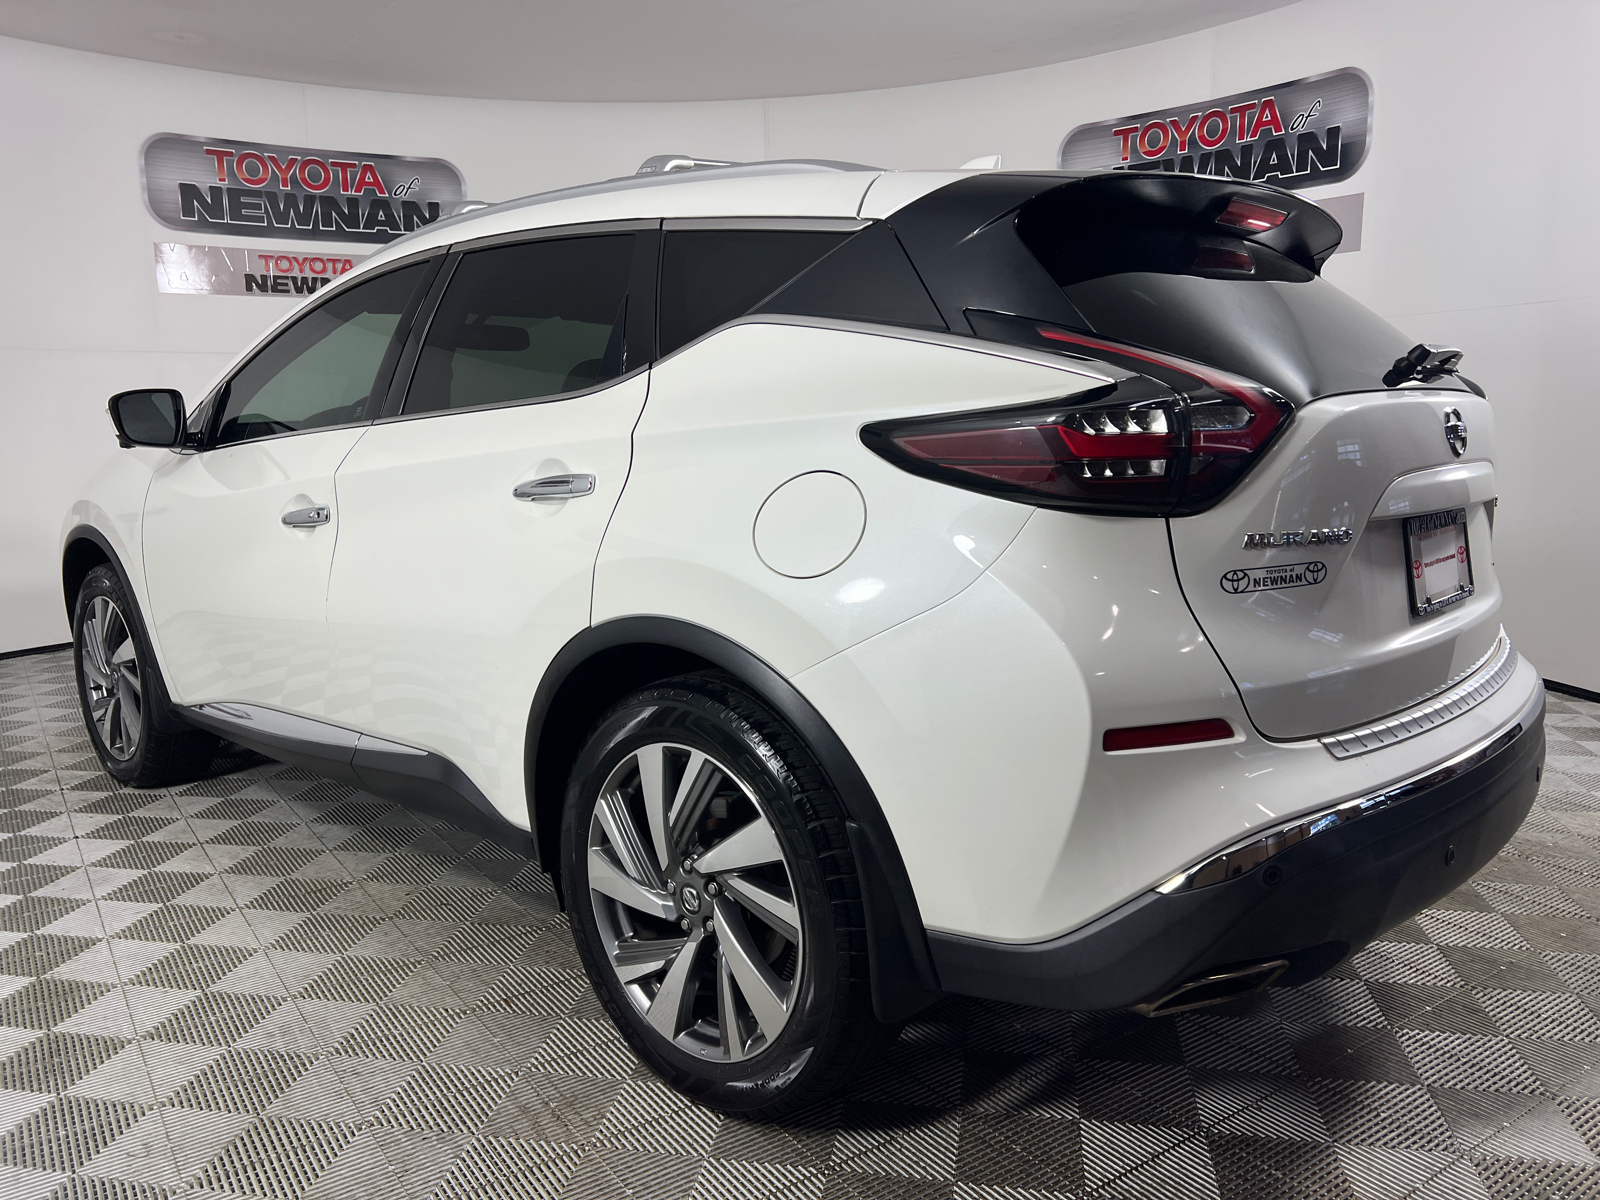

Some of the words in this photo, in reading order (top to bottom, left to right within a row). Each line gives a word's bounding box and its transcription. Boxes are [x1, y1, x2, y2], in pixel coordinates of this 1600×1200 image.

[1113, 97, 1285, 162] TOYOTA
[1289, 99, 1322, 132] of
[204, 147, 388, 196] TOYOTA
[392, 177, 421, 198] of
[177, 182, 440, 234] NEWNAN
[258, 254, 354, 275] TOYOTA
[1241, 527, 1353, 549] MURANO
[1253, 573, 1303, 588] NEWNAN
